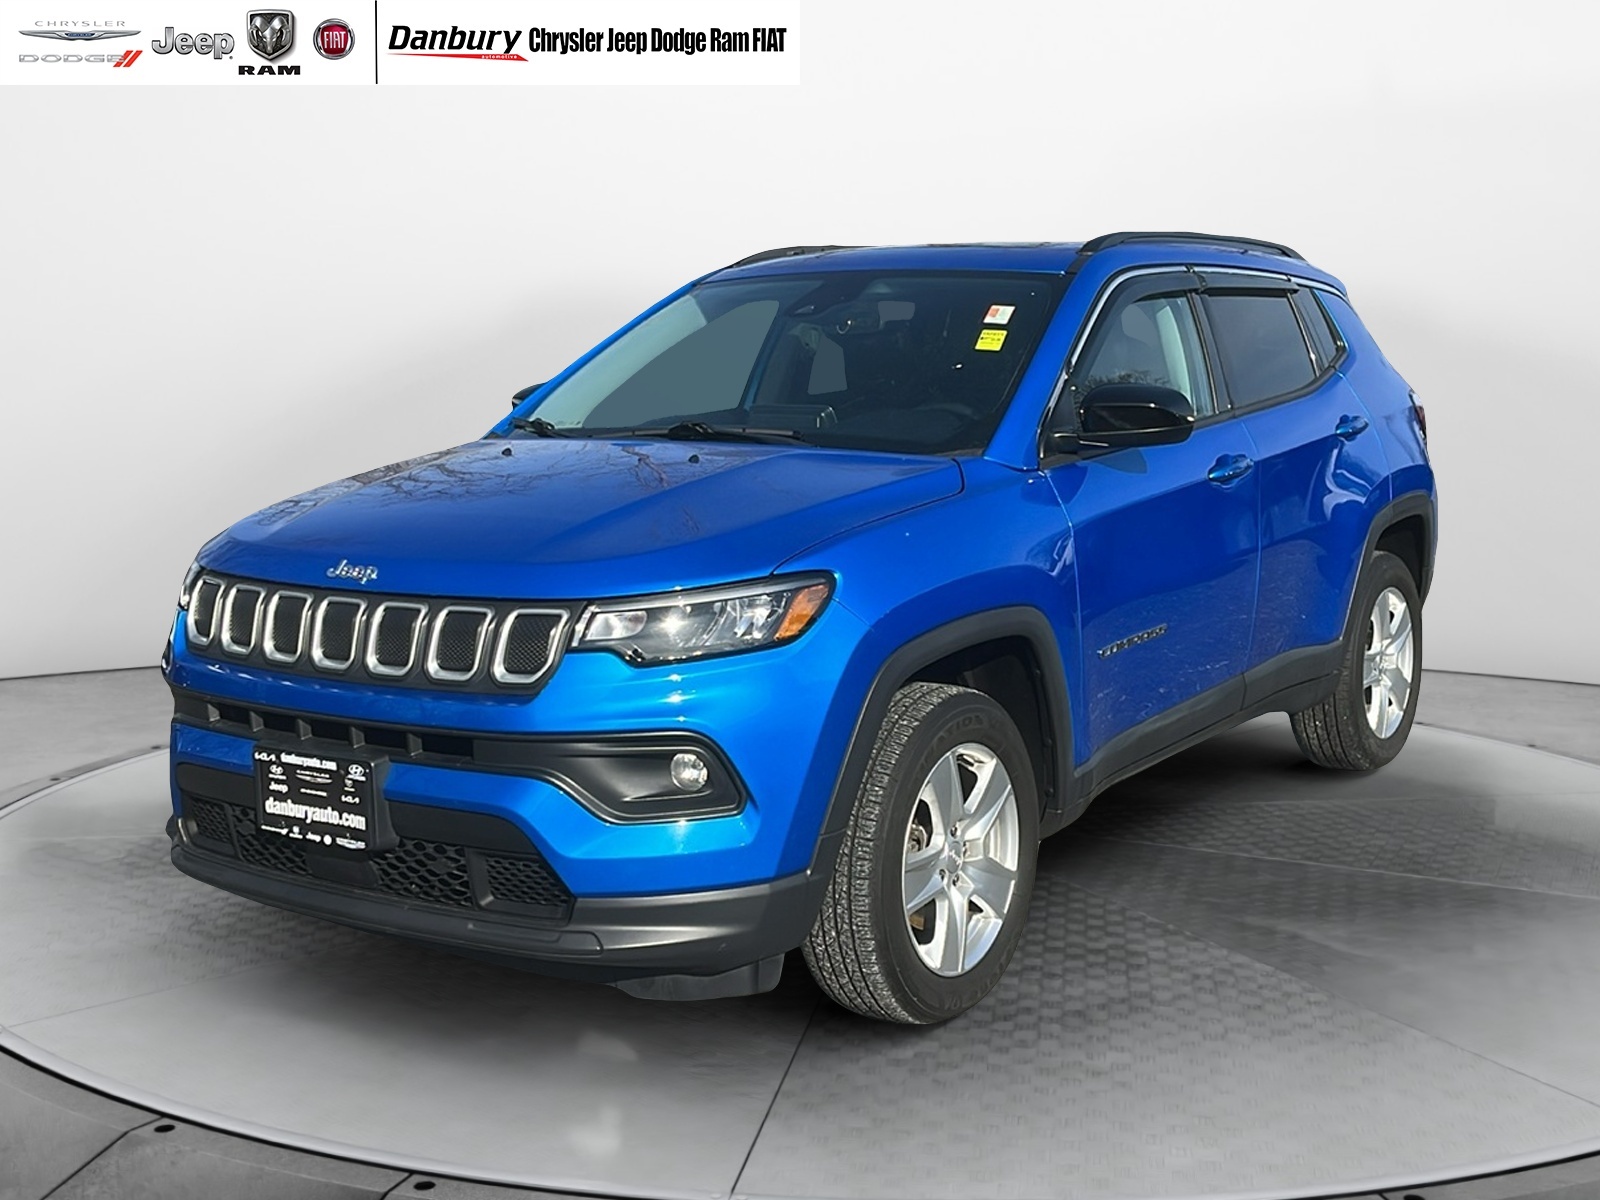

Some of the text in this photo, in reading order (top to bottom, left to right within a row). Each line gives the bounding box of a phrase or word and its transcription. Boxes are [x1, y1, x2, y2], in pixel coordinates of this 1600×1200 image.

[326, 559, 379, 585] Jeep
[269, 781, 289, 794] Jeep
[264, 796, 367, 831] danburyauto.com
